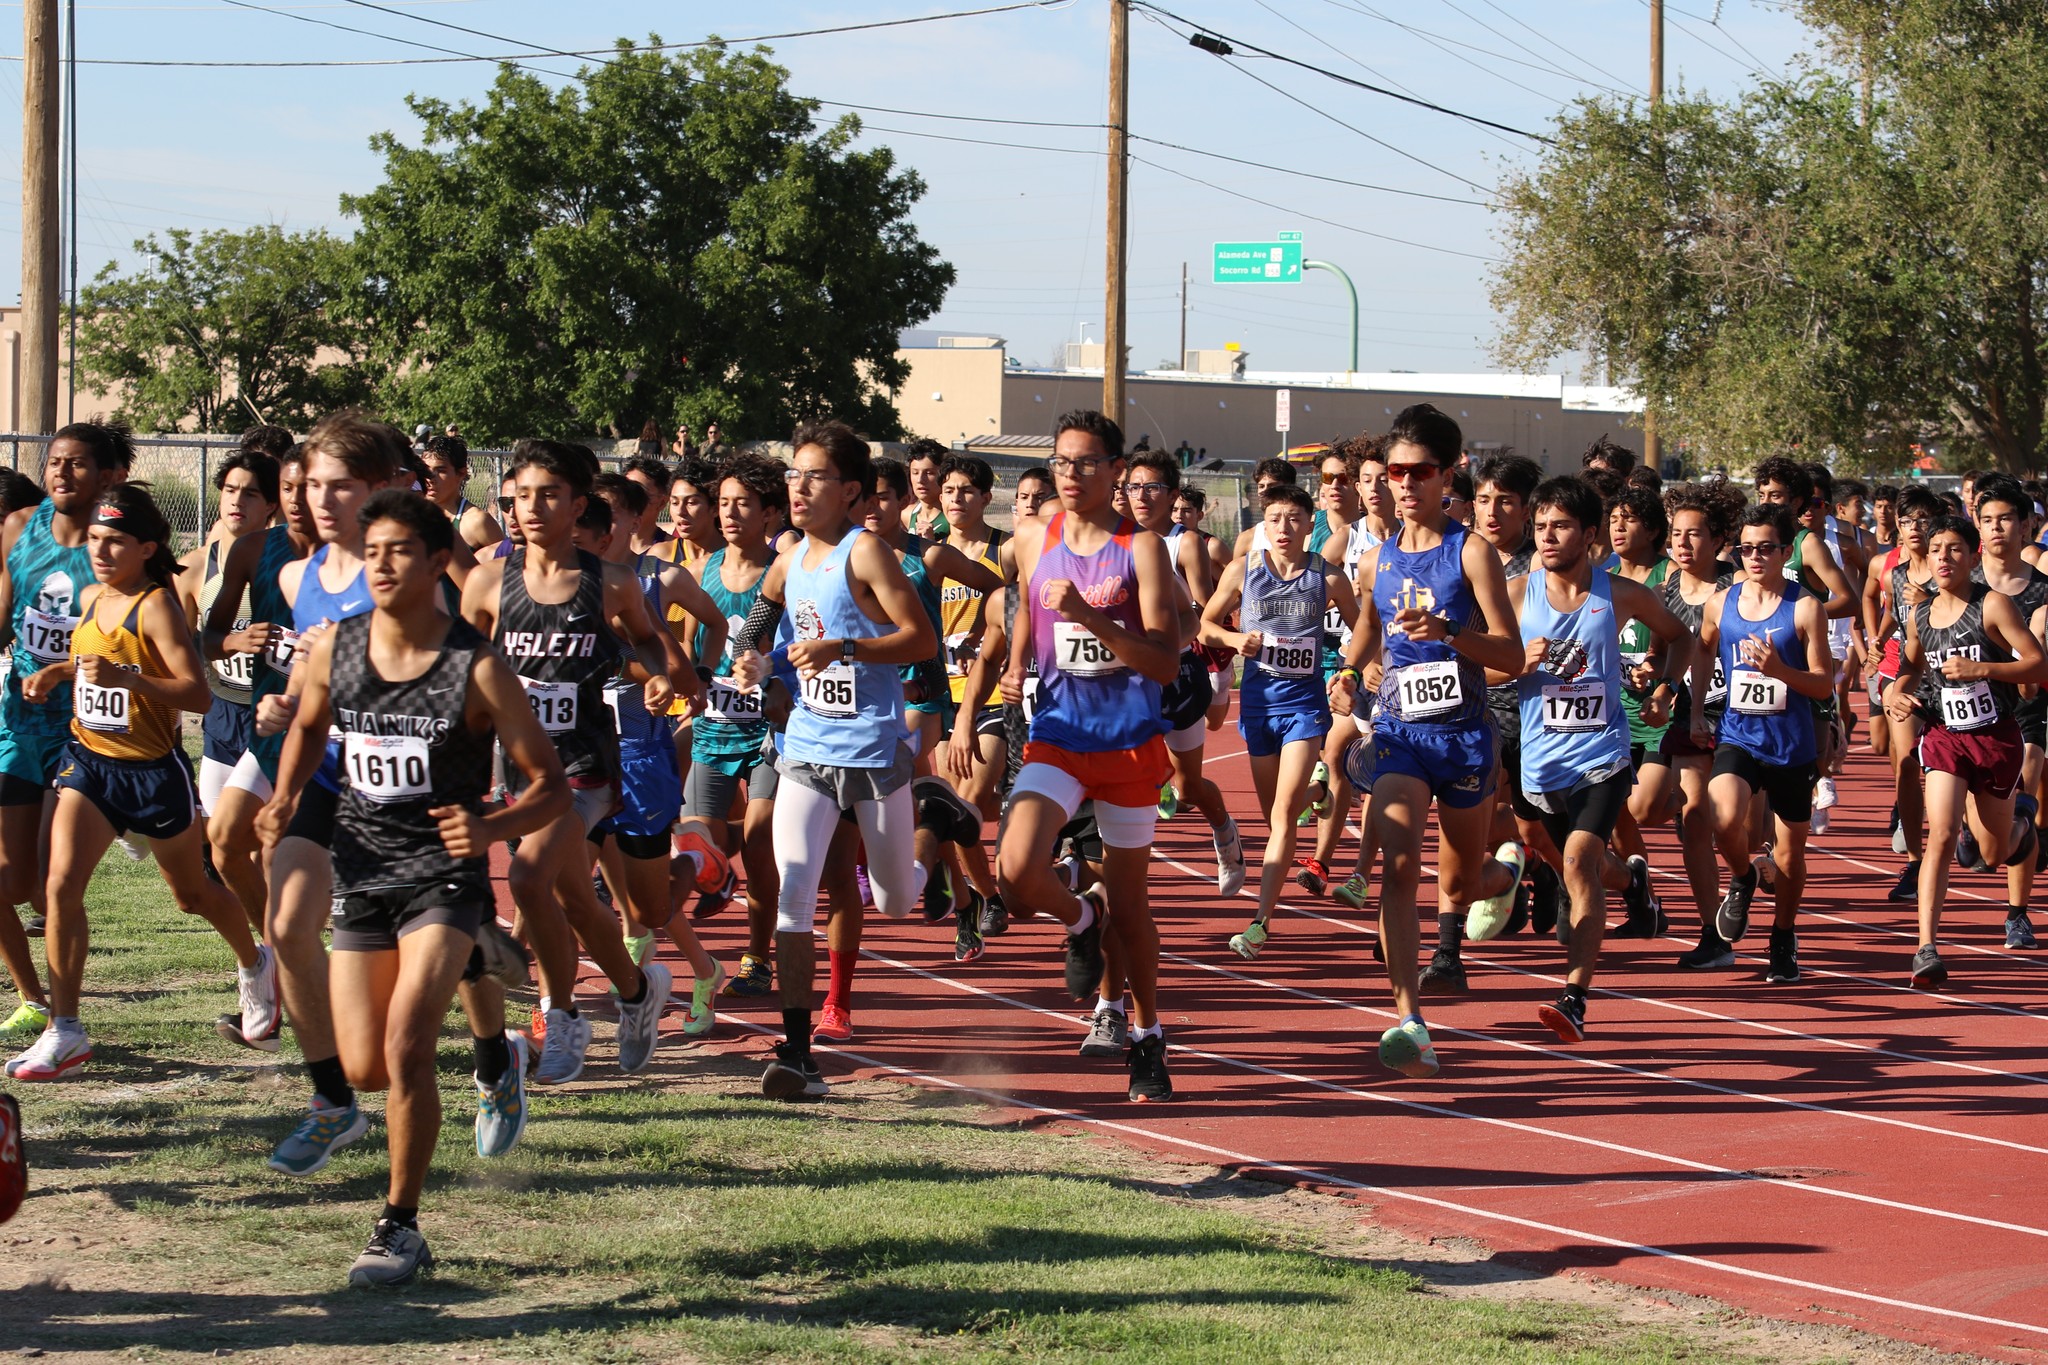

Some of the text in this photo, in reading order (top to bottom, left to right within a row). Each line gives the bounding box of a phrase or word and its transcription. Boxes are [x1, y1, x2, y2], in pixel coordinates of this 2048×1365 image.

[1218, 251, 1250, 259] Alameda
[1252, 251, 1267, 259] Ave
[1219, 266, 1249, 274] Socorro
[1251, 266, 1261, 274] Rd
[1250, 600, 1318, 618] SAN ELIZARIO
[504, 631, 597, 657] YSLETA
[1266, 646, 1313, 669] 1886
[78, 685, 124, 719] 1540
[709, 689, 759, 713] 1735
[806, 676, 852, 705] 1785
[1403, 674, 1459, 705] 1852
[1740, 682, 1775, 705] 781
[528, 694, 574, 724] 813
[1547, 696, 1603, 720] 1787
[1945, 692, 1993, 720] 1815
[338, 708, 450, 746] HANKS
[352, 753, 425, 787] 1610
